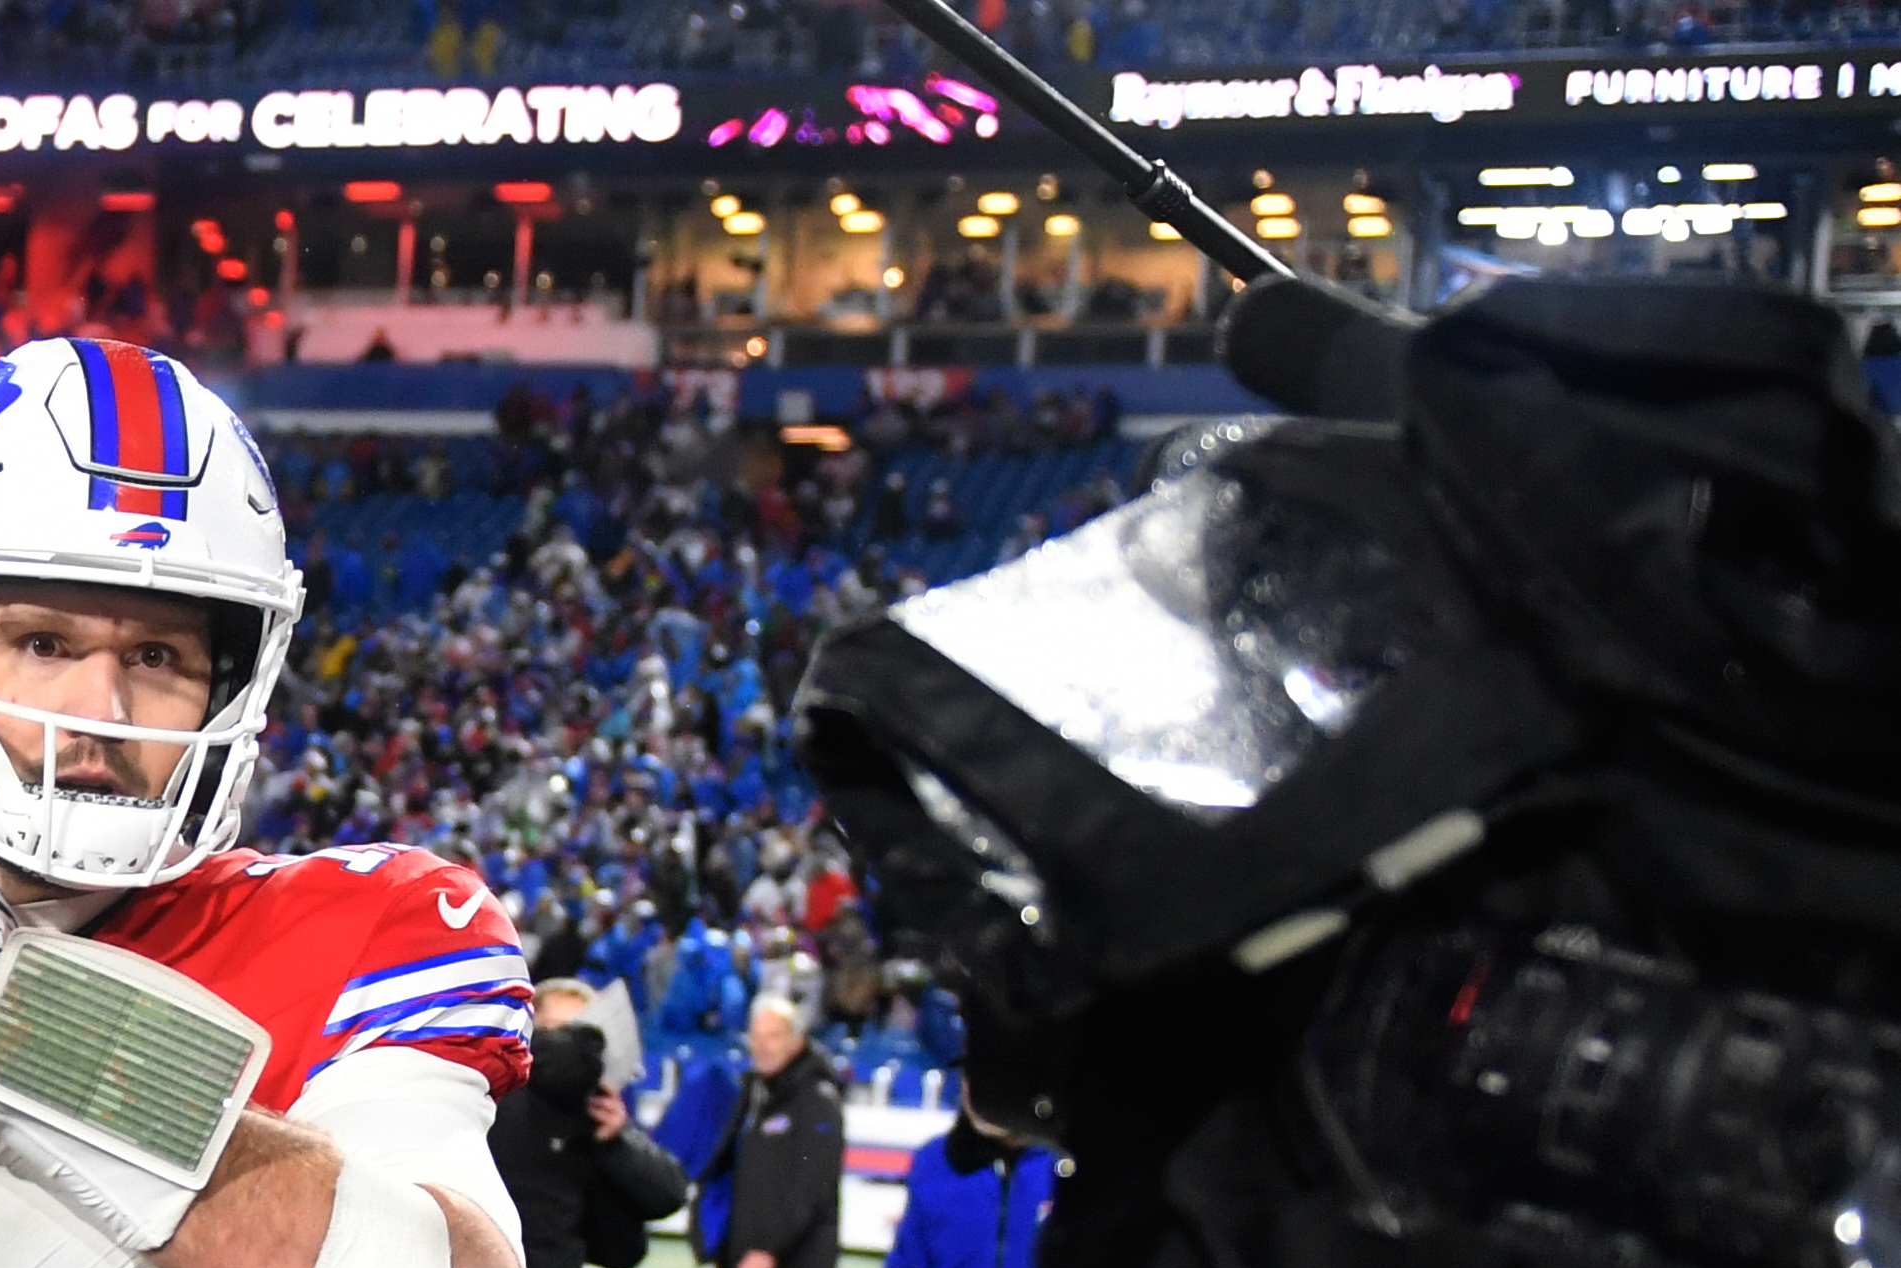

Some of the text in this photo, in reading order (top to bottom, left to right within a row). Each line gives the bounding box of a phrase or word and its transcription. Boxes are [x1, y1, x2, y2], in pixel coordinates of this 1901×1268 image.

[1566, 65, 1823, 105] FURNITURE
[147, 100, 243, 143] FOR
[252, 84, 681, 149] CELEBRATING
